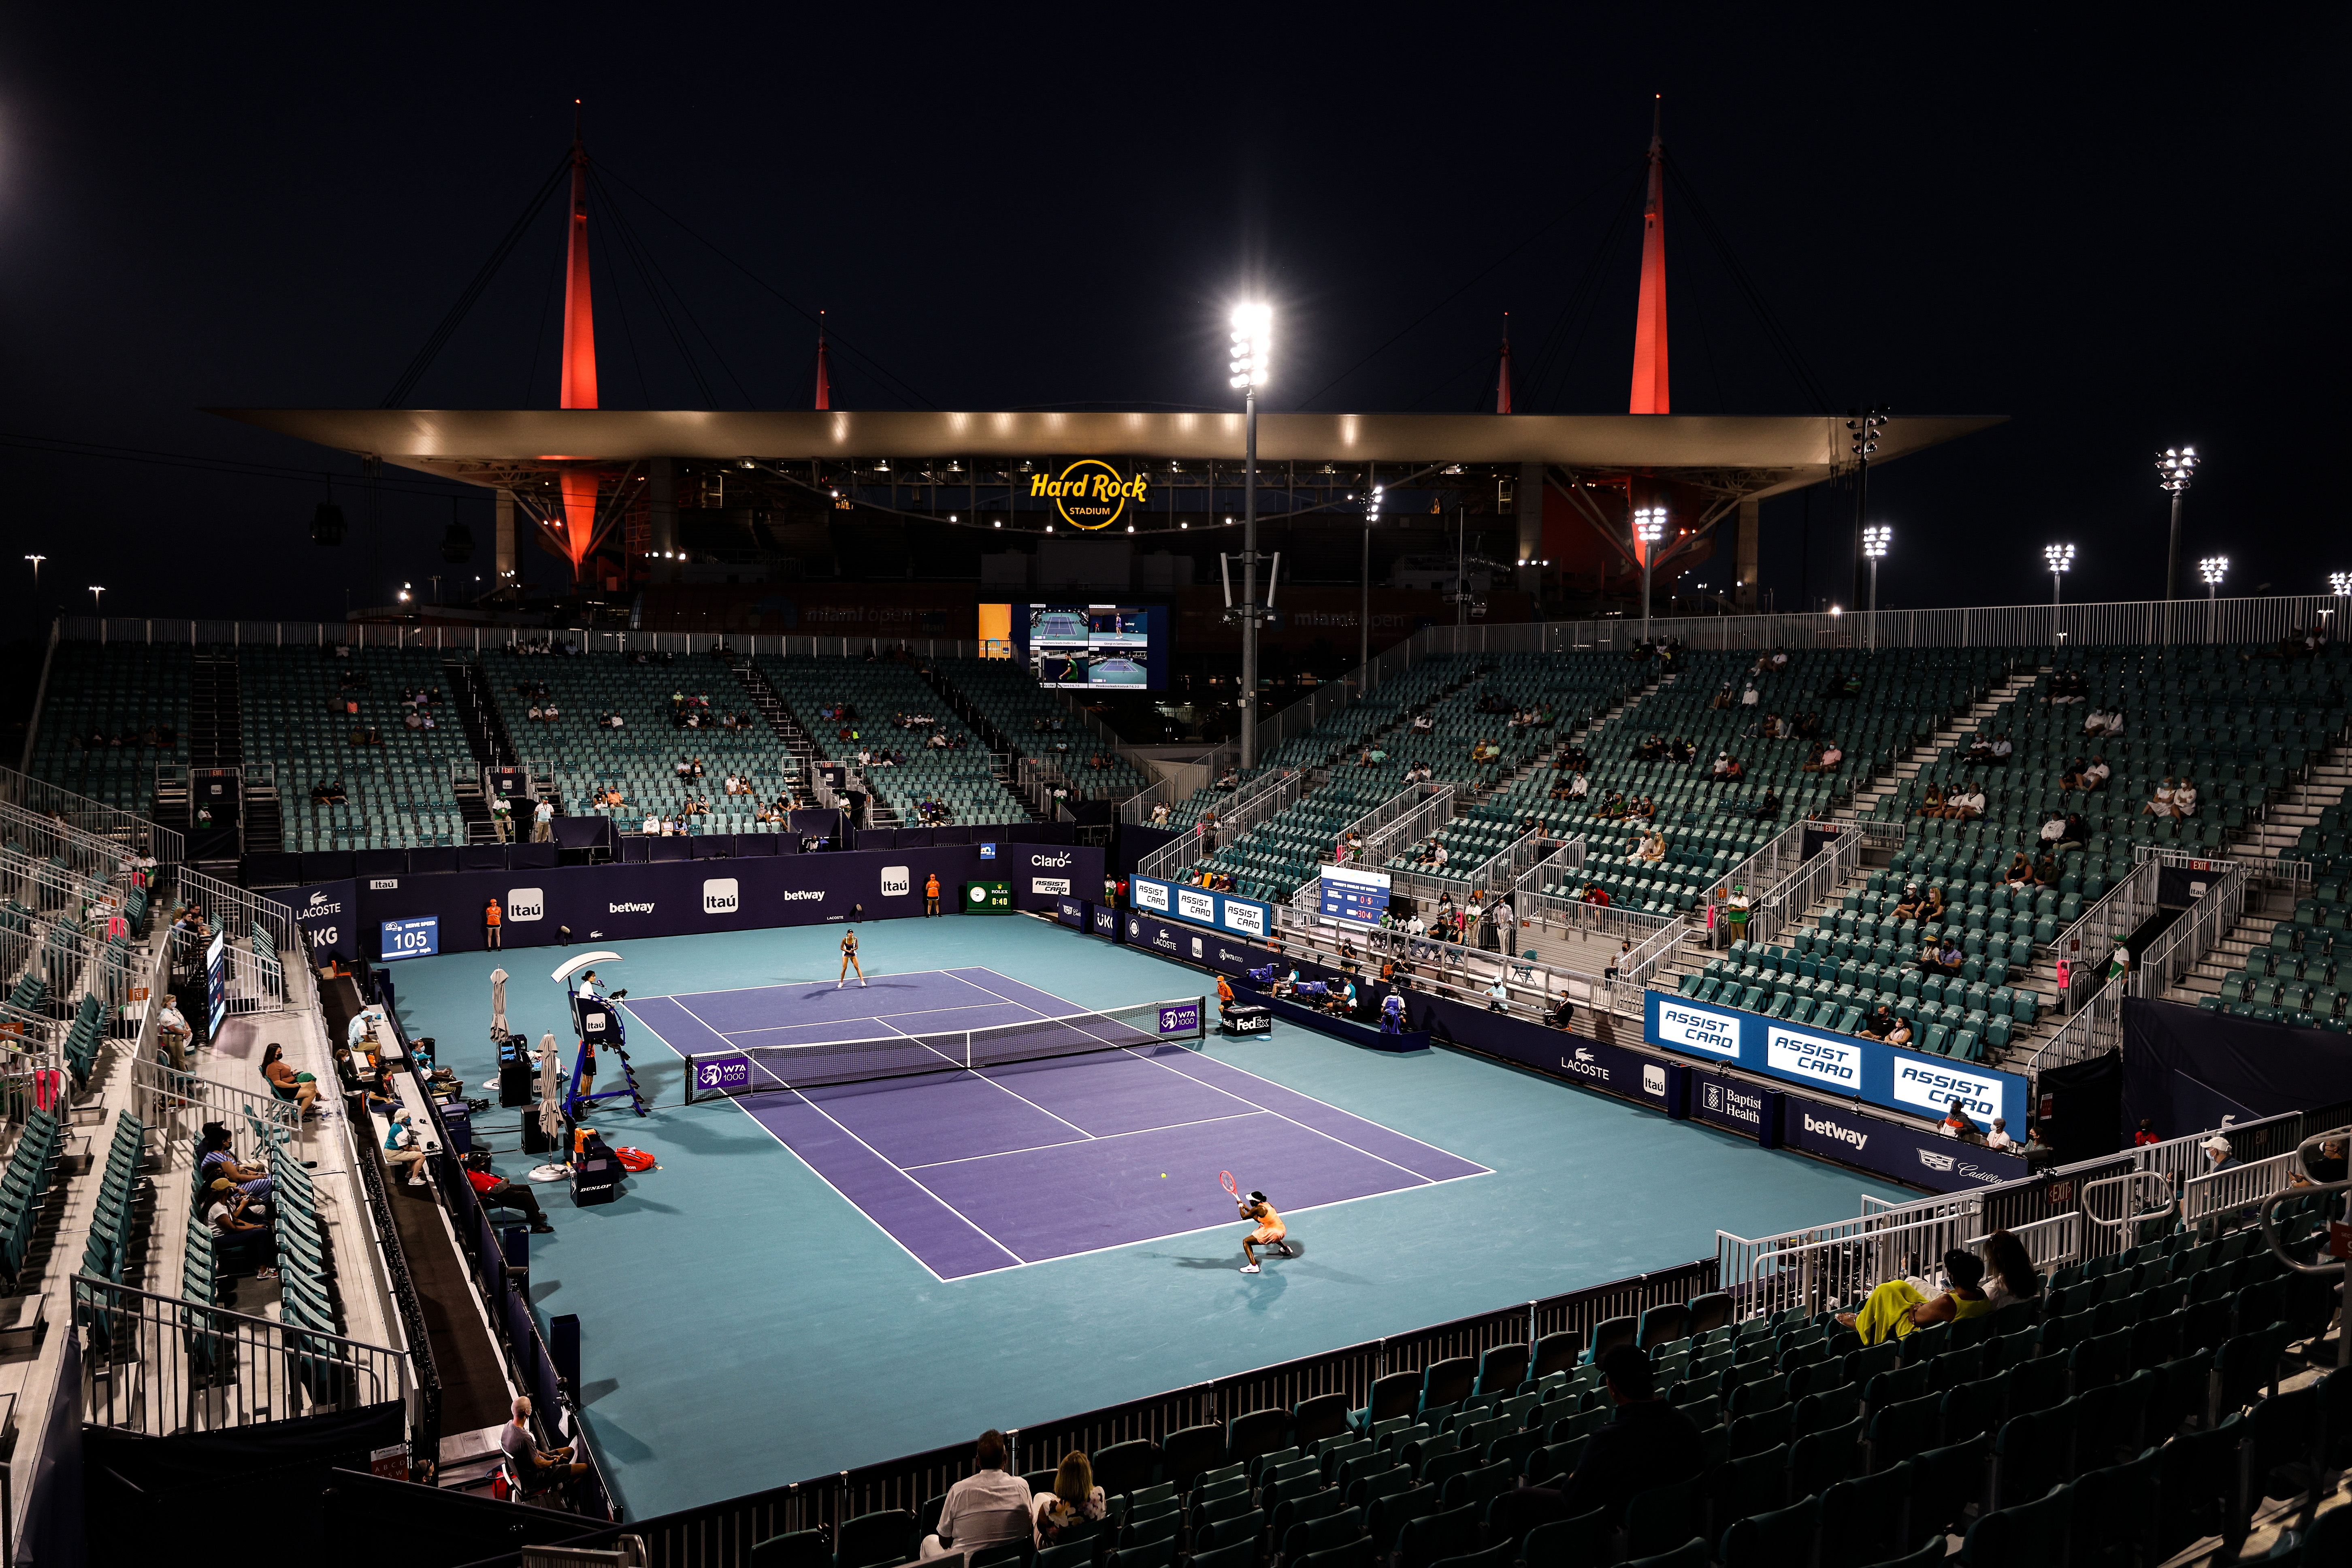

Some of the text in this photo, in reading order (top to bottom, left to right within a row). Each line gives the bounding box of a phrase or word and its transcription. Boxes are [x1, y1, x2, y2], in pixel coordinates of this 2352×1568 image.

[1030, 474, 1147, 502] Hard Rock
[807, 606, 913, 625] miami open
[1295, 610, 1354, 625] miami
[1031, 854, 1065, 867] Claro
[2194, 861, 2207, 870] EXIT
[884, 880, 907, 891] Itaú
[1139, 885, 1163, 897] ASSIST
[706, 895, 735, 908] Itaú
[784, 891, 825, 901] betway
[1147, 896, 1165, 905] CARD
[1181, 895, 1208, 907] ASSIST
[296, 903, 341, 920] LACOSTE
[511, 903, 541, 916] Itaú
[609, 902, 655, 913] betway
[1190, 906, 1210, 917] CARD
[1228, 906, 1258, 920] ASSIST
[1358, 910, 1366, 918] 30
[1237, 918, 1259, 929] CARD
[308, 927, 338, 947] KG
[394, 931, 427, 949] 105
[1153, 936, 1176, 951] LACOSTE
[1192, 944, 1201, 955] Itaú
[1223, 1018, 1234, 1028] FedEx
[1237, 1016, 1269, 1030] FedEx
[1665, 1011, 1730, 1033] ASSIST
[1685, 1029, 1733, 1048] CARD
[1775, 1037, 1849, 1063] ASSIST
[723, 1064, 746, 1073] WTA
[1562, 1057, 1609, 1080] LACOSTE
[1797, 1057, 1853, 1079] CARD
[723, 1072, 744, 1081] 1000
[1901, 1067, 1989, 1097] ASSIST
[1645, 1077, 1664, 1092] Itaú
[1727, 1088, 1762, 1110] Baptist
[1928, 1089, 1993, 1116] CARD
[1726, 1103, 1760, 1124] Health
[1804, 1114, 1868, 1150] betway
[2256, 1129, 2268, 1144] EXIT
[580, 1183, 611, 1192] DUNLOP
[2053, 1182, 2069, 1201] EXIT
